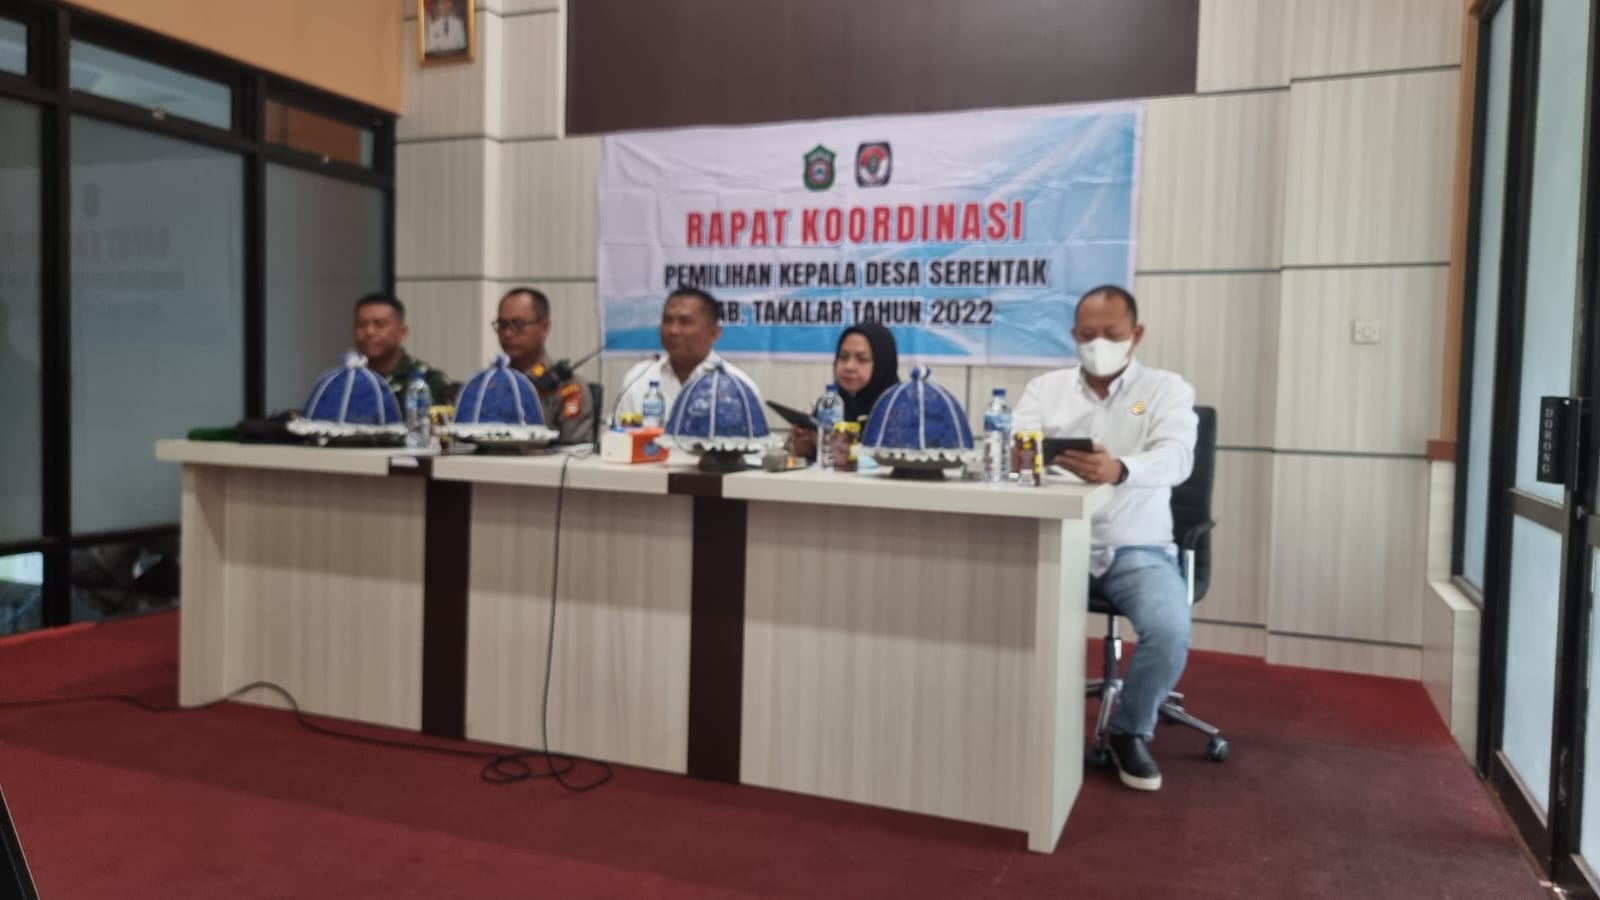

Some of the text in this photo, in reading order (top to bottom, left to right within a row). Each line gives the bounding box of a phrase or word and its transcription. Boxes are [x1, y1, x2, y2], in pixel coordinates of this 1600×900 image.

[686, 200, 1025, 247] RAPAT KOORDINASI
[664, 258, 1048, 288] PEMILIHAN KEPALA DESA SERENTAK
[715, 300, 994, 324] AB. TAKALAR TAHUN 2022
[1541, 407, 1554, 475] DORONG
